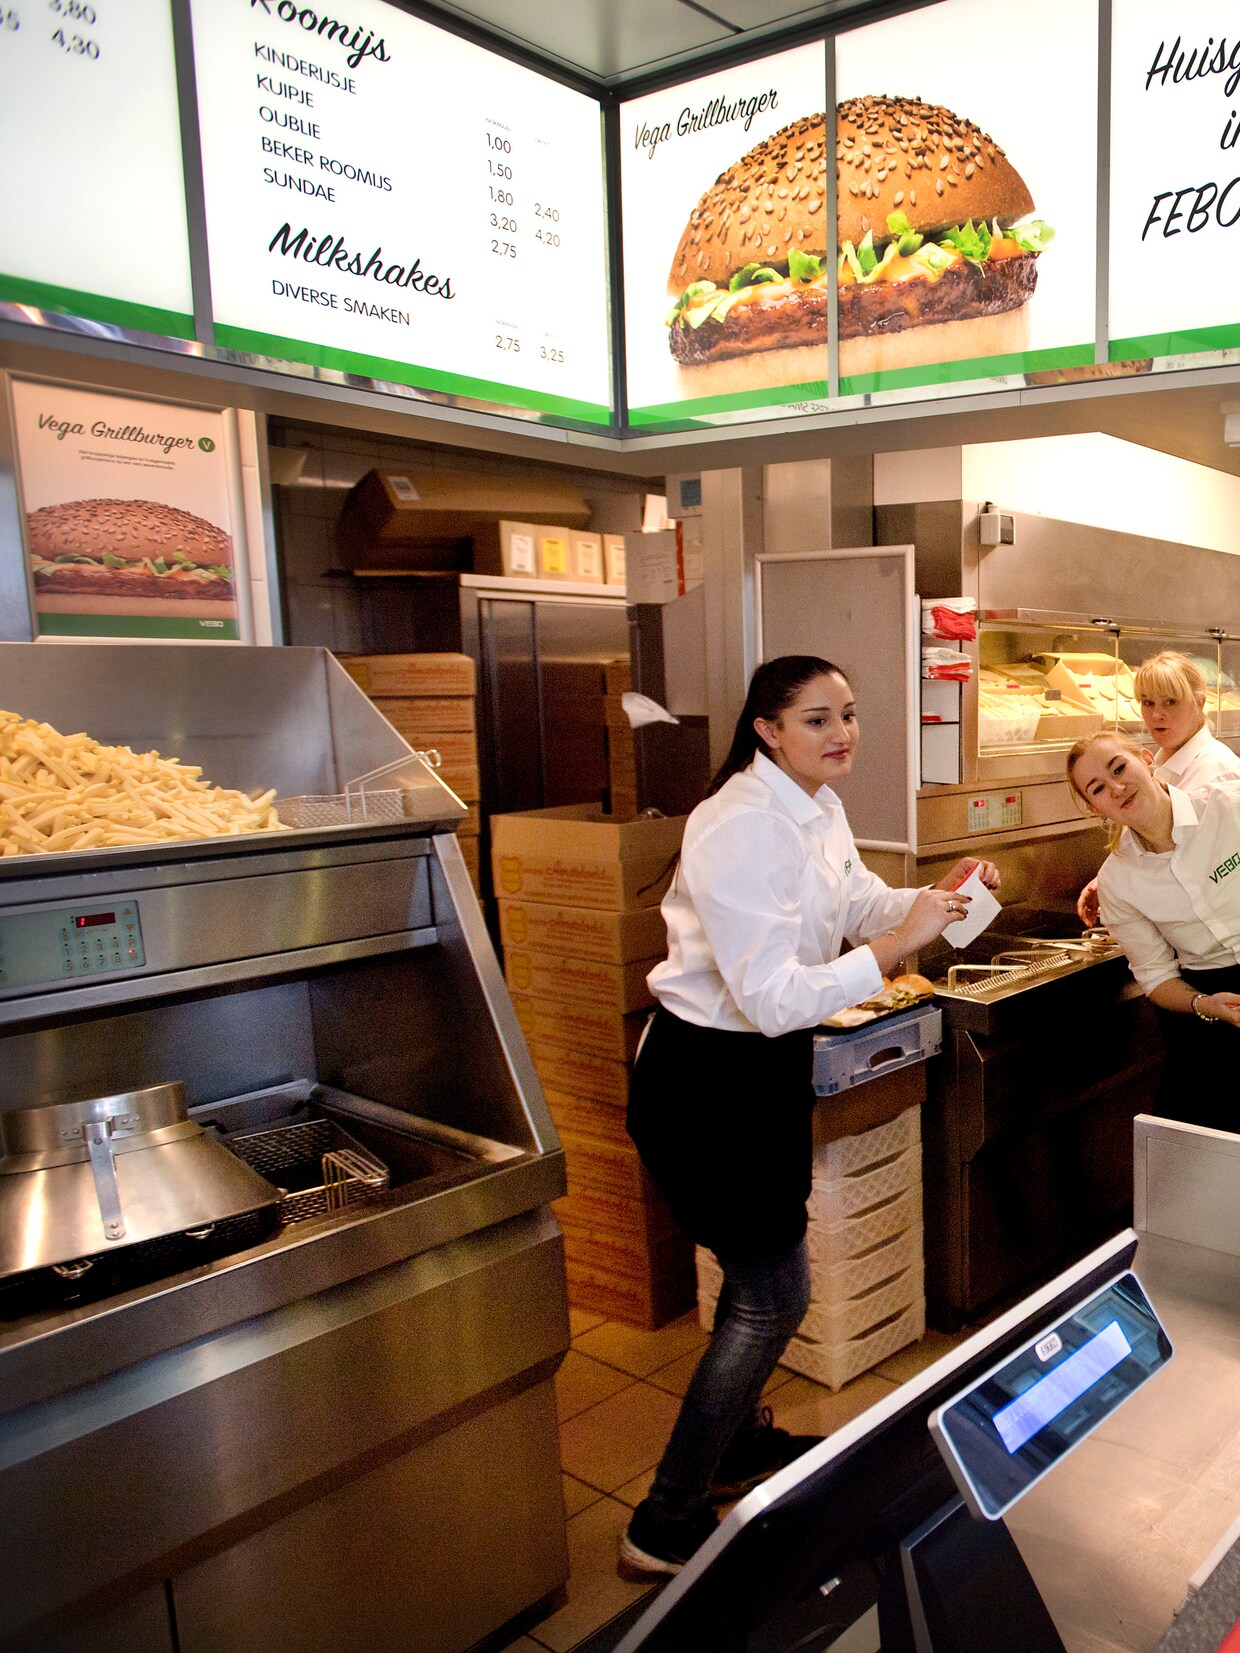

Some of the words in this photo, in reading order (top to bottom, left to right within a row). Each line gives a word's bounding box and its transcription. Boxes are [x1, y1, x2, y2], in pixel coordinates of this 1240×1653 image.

[51, 28, 100, 60] 4,30
[254, 41, 358, 95] KINDERIJSJE
[256, 73, 315, 108] KUIPJE
[258, 105, 322, 140] OUBLIE
[634, 121, 672, 160] Vega
[676, 88, 779, 137] Grillburger
[486, 132, 512, 154] 1,00
[261, 135, 315, 168] BEKER
[319, 155, 393, 192] ROOMIJS
[487, 159, 513, 180] 1,50
[263, 167, 336, 203] SUNDAE
[488, 185, 514, 206] 1,80
[534, 202, 560, 223] 2,40
[490, 212, 518, 233] 3,20
[535, 229, 561, 248] 4,20
[268, 222, 457, 301] Milkshakes
[491, 239, 517, 259] 2,75
[272, 279, 339, 309] DIVERSE
[343, 297, 411, 327] SMAKEN
[495, 334, 521, 353] 2,75
[540, 345, 565, 363] 3,25
[38, 412, 86, 442] Vega
[90, 421, 196, 455] Grillburger
[198, 619, 225, 628] VEBO
